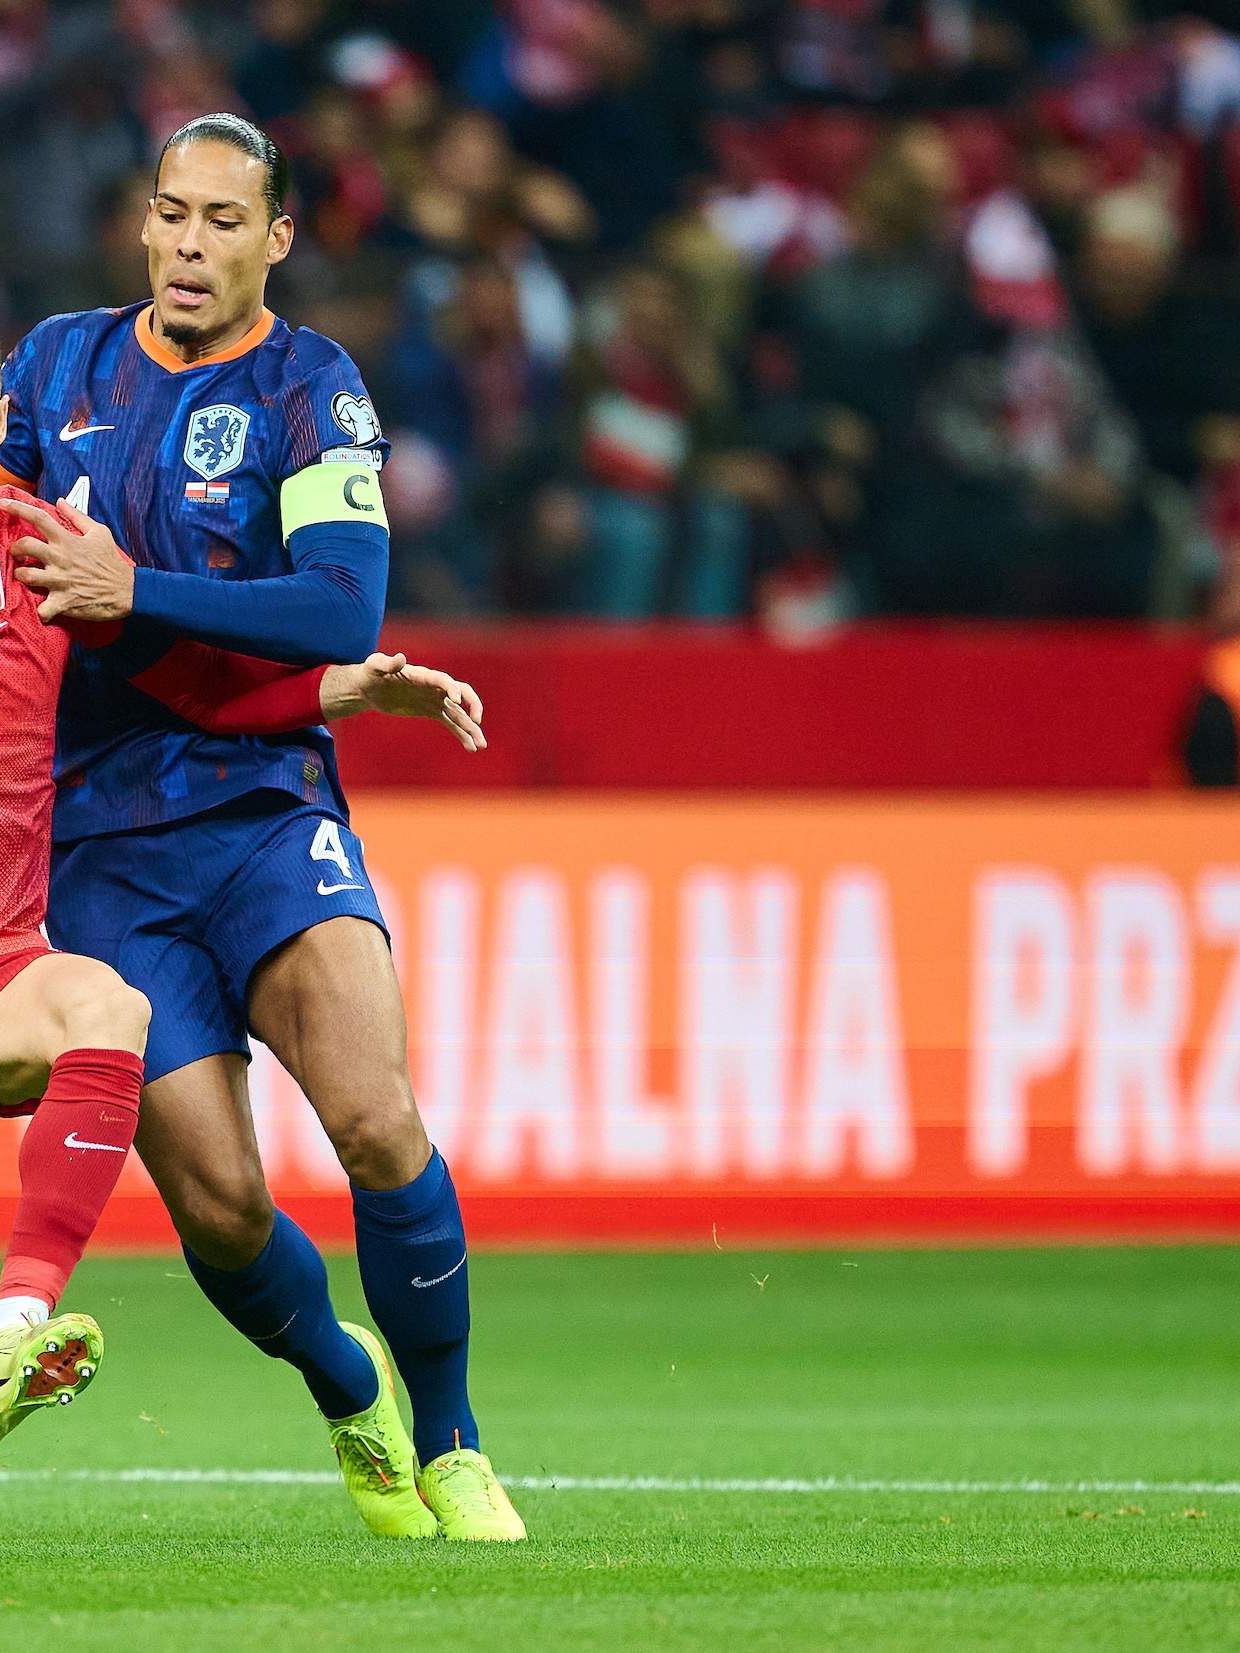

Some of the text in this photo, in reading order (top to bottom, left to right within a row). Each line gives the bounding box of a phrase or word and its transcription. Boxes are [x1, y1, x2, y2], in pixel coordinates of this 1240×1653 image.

[323, 453, 371, 461] FOUNDATION
[343, 474, 375, 511] C
[310, 818, 353, 880] 4
